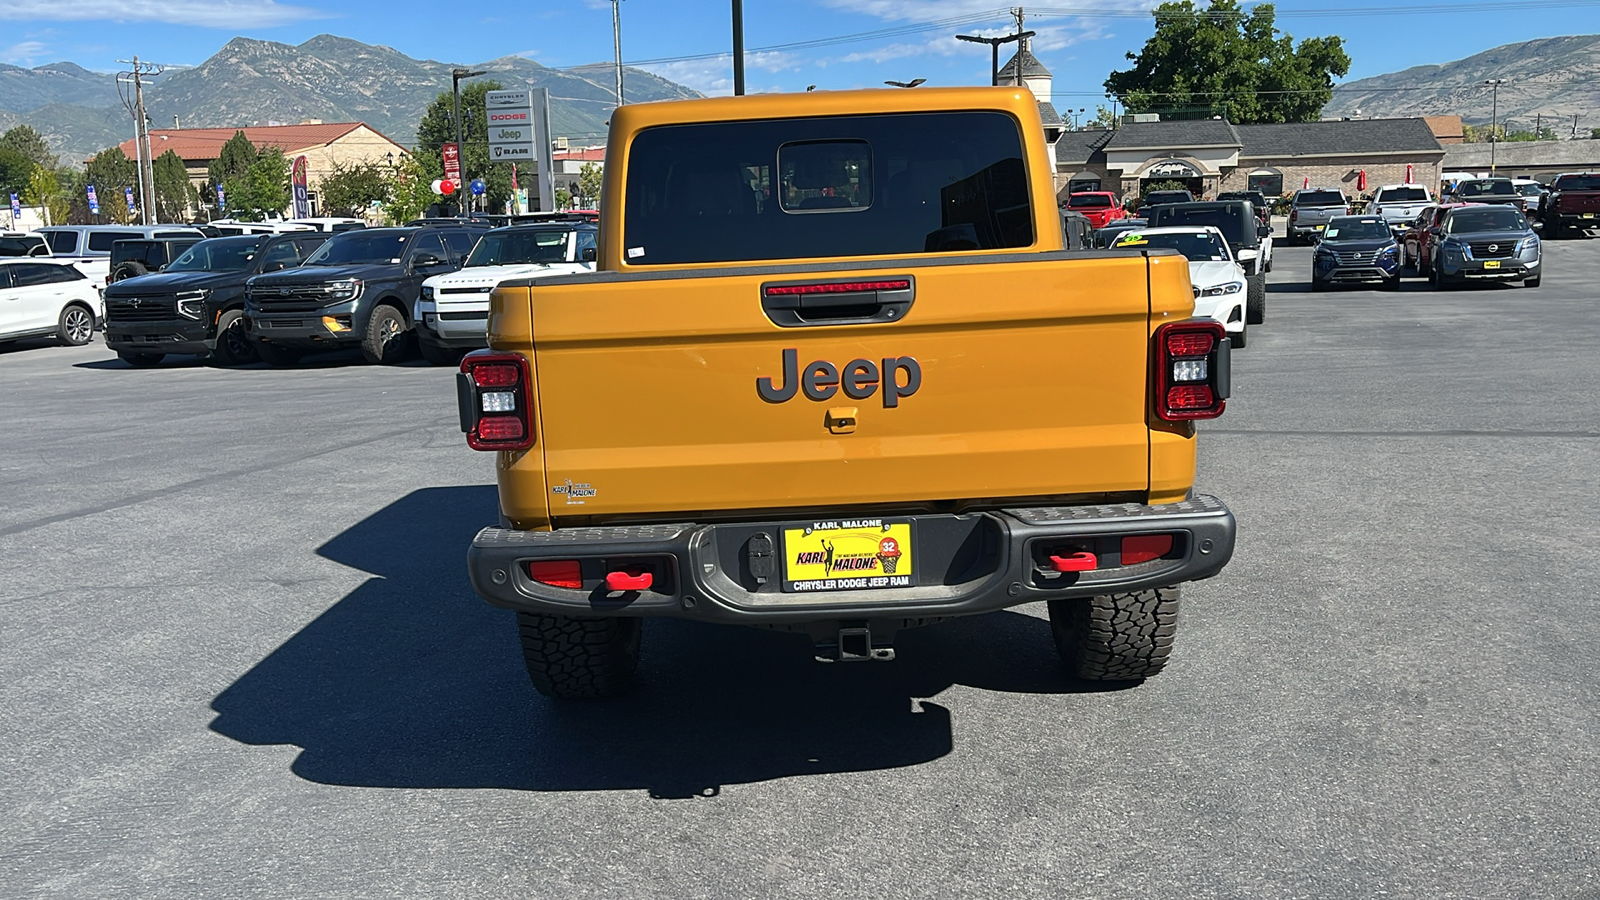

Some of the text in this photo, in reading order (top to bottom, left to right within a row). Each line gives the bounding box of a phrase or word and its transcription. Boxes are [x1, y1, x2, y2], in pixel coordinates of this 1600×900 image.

[498, 129, 521, 140] Jeep
[756, 348, 922, 409] Jeep
[813, 520, 882, 530] KARL MALONE
[882, 542, 895, 551] 32
[796, 551, 826, 565] KARL
[832, 557, 878, 572] MALONE
[793, 576, 909, 591] CHRYSLER DODGE JEEP RAM
